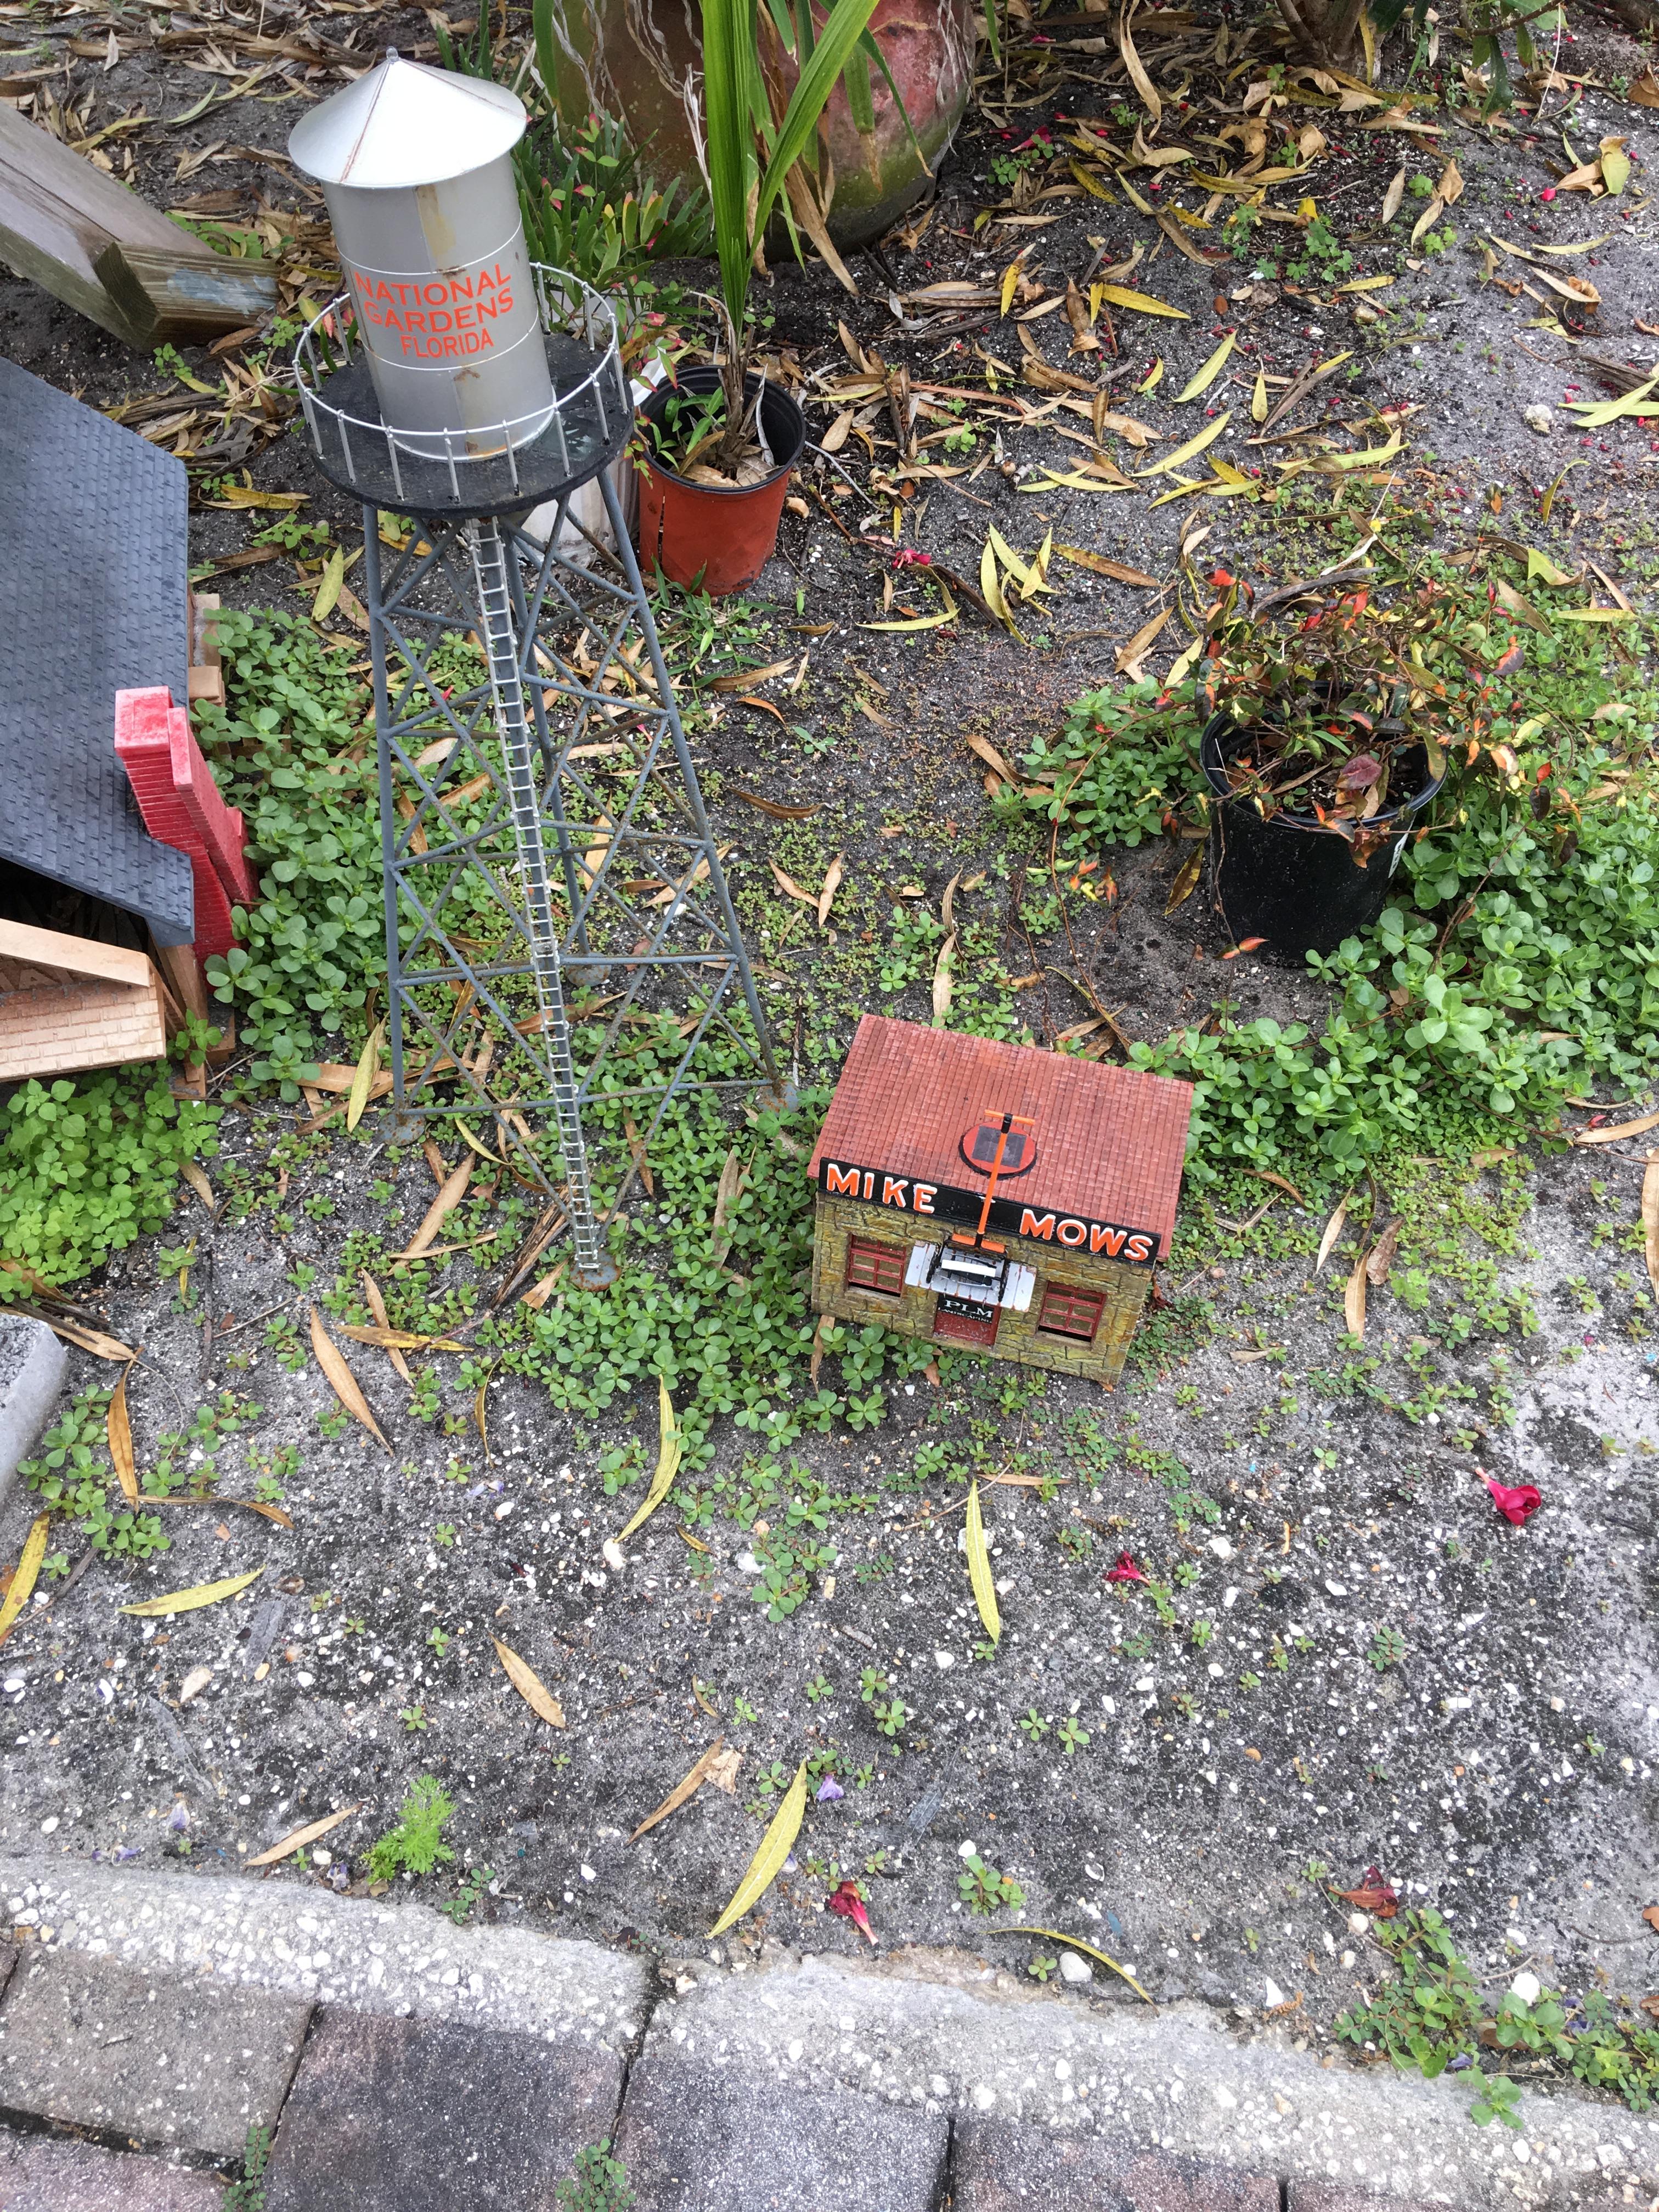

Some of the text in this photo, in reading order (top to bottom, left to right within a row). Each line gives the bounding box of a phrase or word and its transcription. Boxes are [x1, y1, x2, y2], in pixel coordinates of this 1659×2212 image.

[354, 263, 511, 306] NATIONAL
[364, 287, 514, 333] GARDENS
[400, 327, 494, 359] FLORIDA
[826, 1163, 1154, 1261] MIKE MOWS
[944, 1299, 994, 1318] PLM
